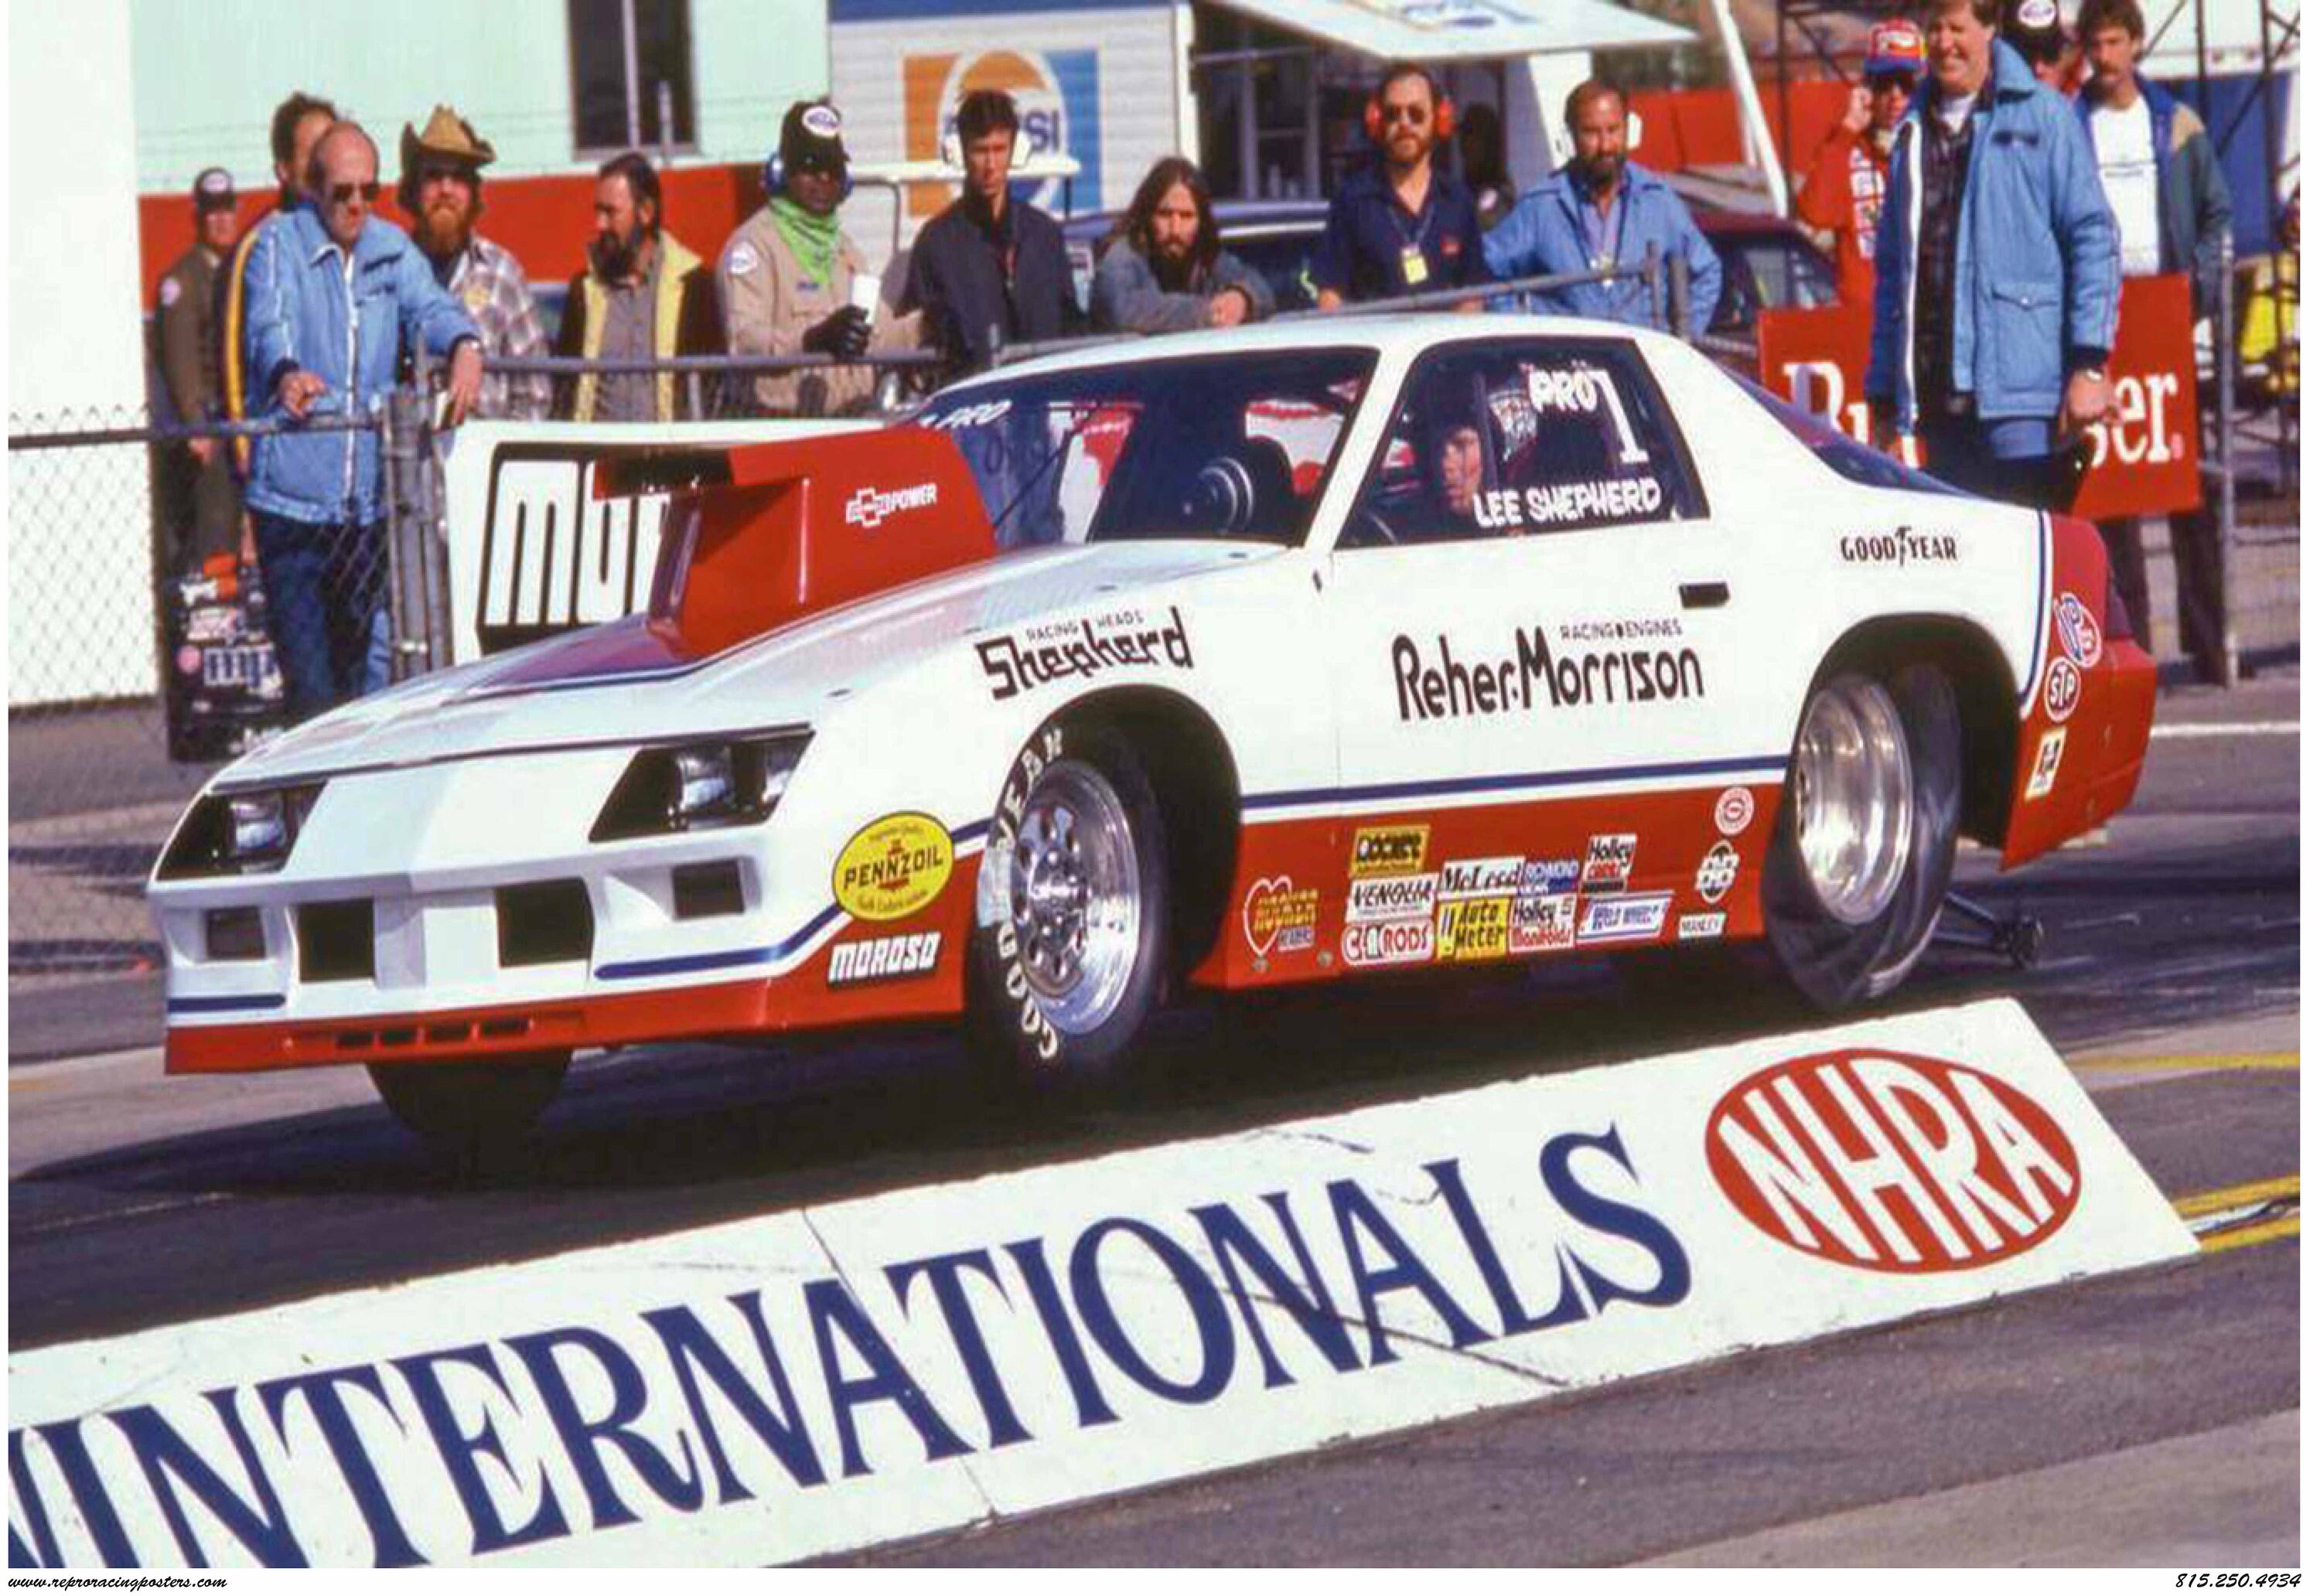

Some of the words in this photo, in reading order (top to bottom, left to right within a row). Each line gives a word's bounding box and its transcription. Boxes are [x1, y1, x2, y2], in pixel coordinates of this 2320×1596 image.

[1529, 370, 1598, 413] PRO
[1587, 368, 1649, 463] 1
[892, 483, 937, 512] POWER
[1472, 489, 1523, 529] LEE
[1526, 476, 1662, 523] SHEPHERD
[1025, 620, 1079, 643] RACING
[1097, 609, 1145, 629] HEADS
[1560, 621, 1615, 642] RACING
[1626, 618, 1683, 639] ENGINES
[974, 605, 1194, 701] Shepherd
[2049, 661, 2076, 708] STP
[843, 844, 944, 892] PENNZOIL
[1589, 837, 1636, 868] Holley
[1442, 861, 1522, 891] McLeod
[1459, 902, 1499, 923] Auto
[1513, 896, 1556, 927] Holley
[1383, 924, 1428, 953] RODS
[1455, 926, 1504, 948] Meter
[827, 930, 942, 984] MOROSO
[1718, 1057, 2075, 1263] NHRA
